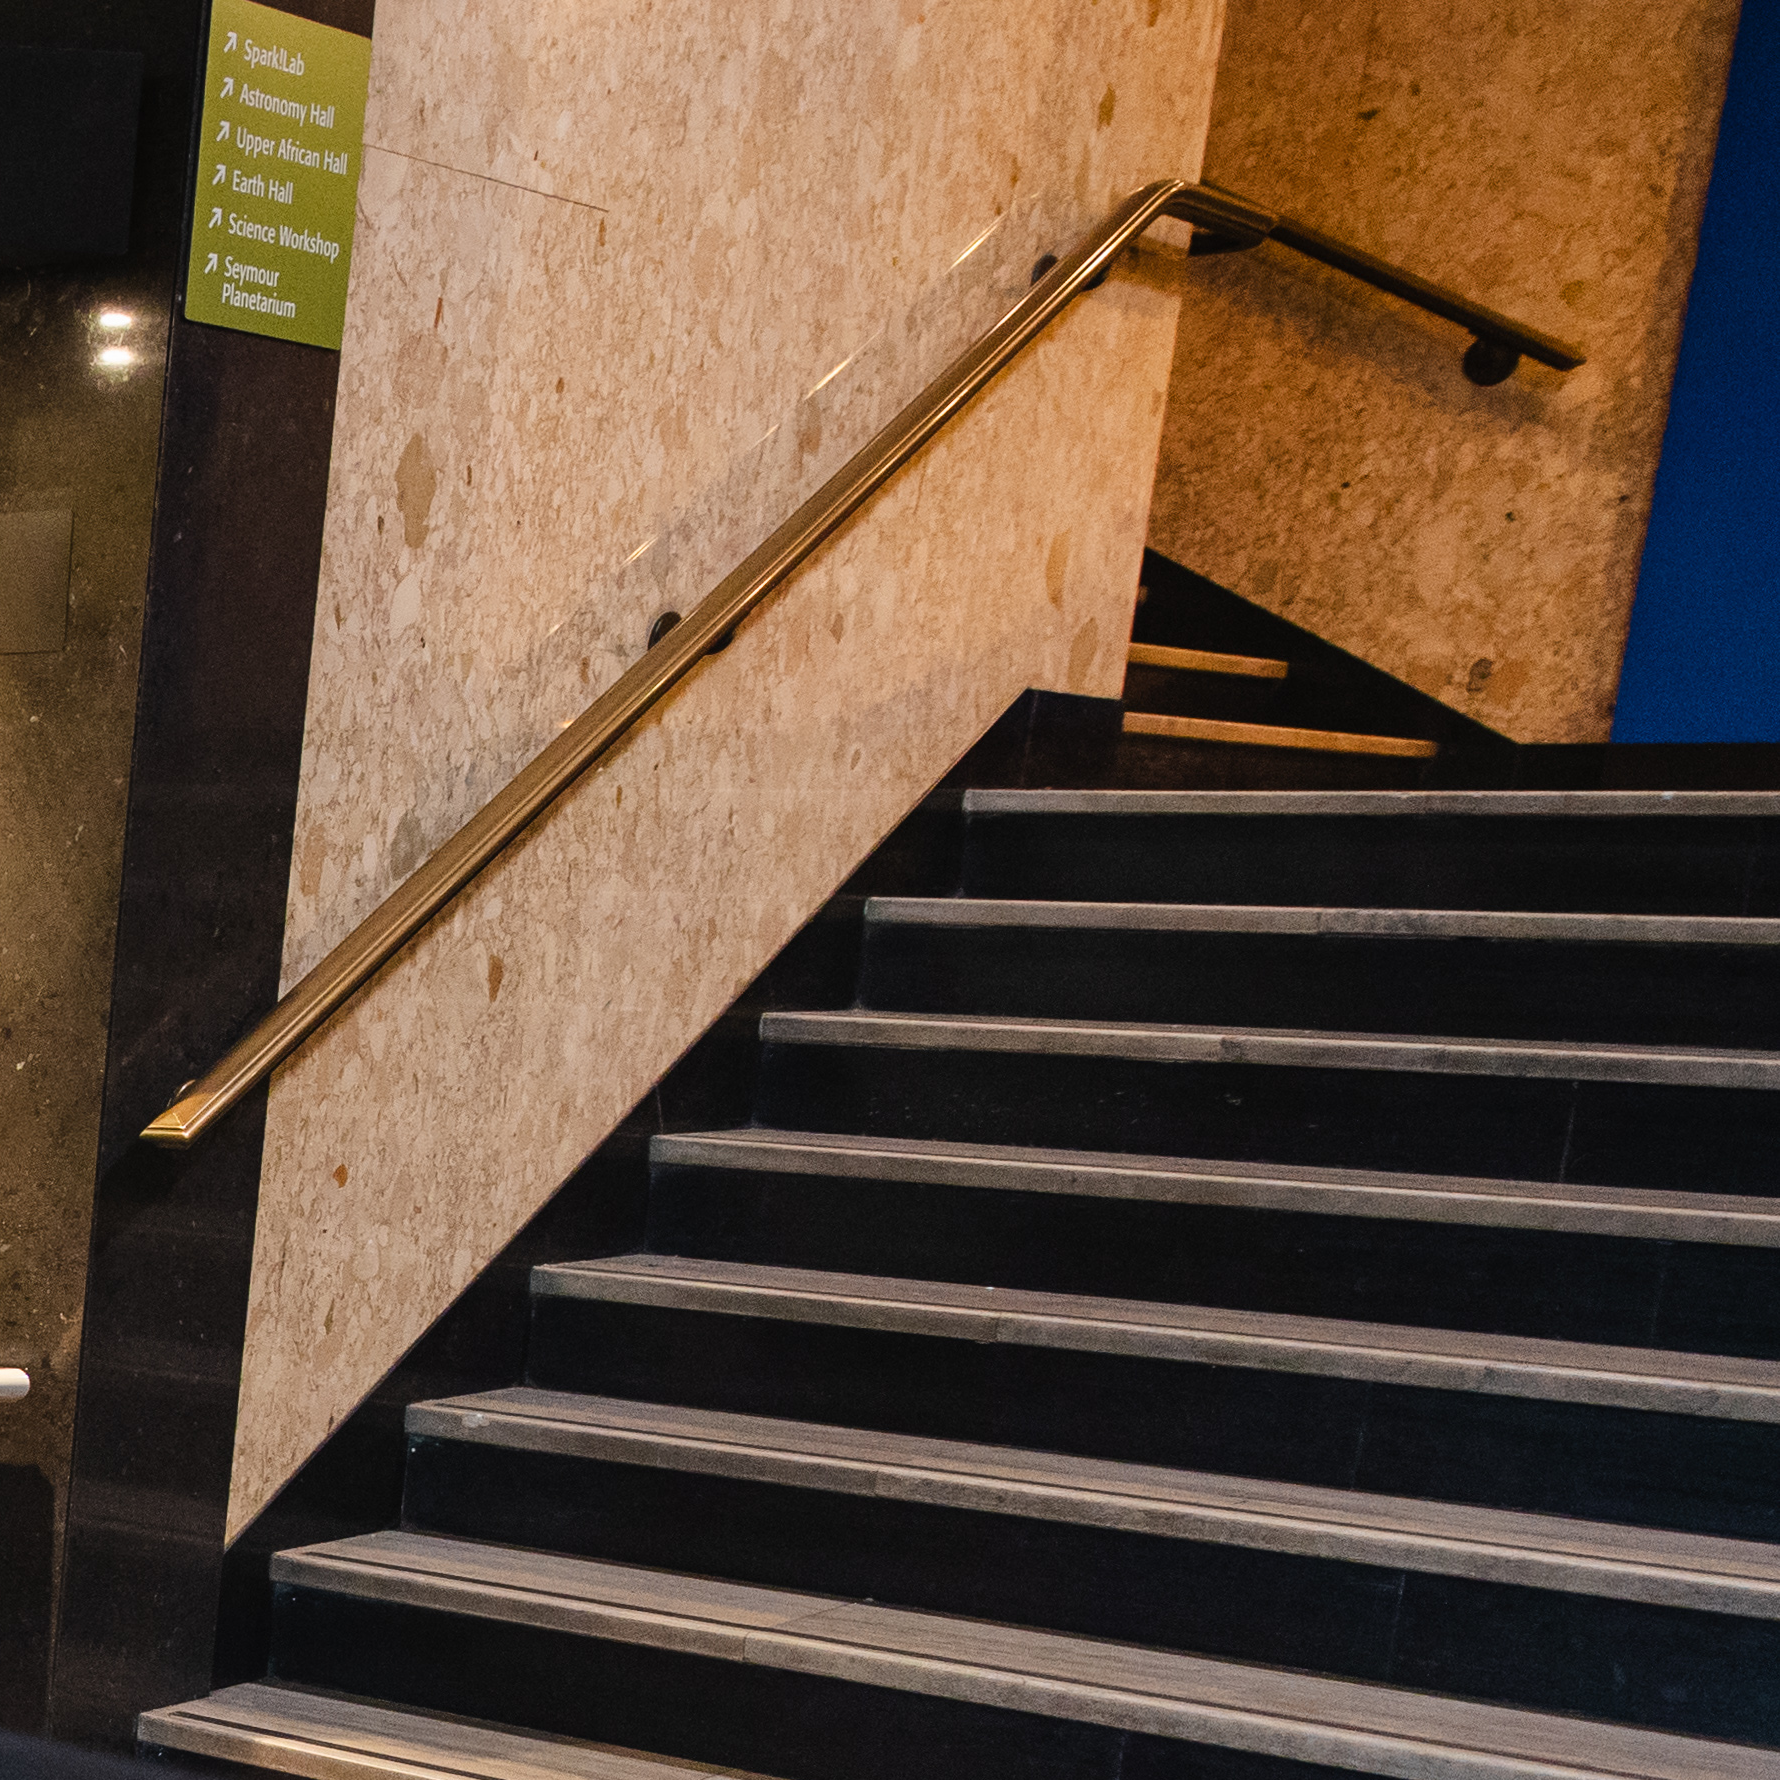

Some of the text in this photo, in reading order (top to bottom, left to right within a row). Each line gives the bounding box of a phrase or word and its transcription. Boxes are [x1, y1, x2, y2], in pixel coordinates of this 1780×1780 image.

[244, 38, 305, 76] Spark!Lab
[239, 83, 335, 129] Astronomy Hall
[236, 126, 348, 175] Upper African Hall
[232, 169, 294, 204] Earth Hall
[227, 212, 340, 264] Science Workshop
[223, 255, 280, 288] Seymour
[221, 283, 296, 319] Planetarium
